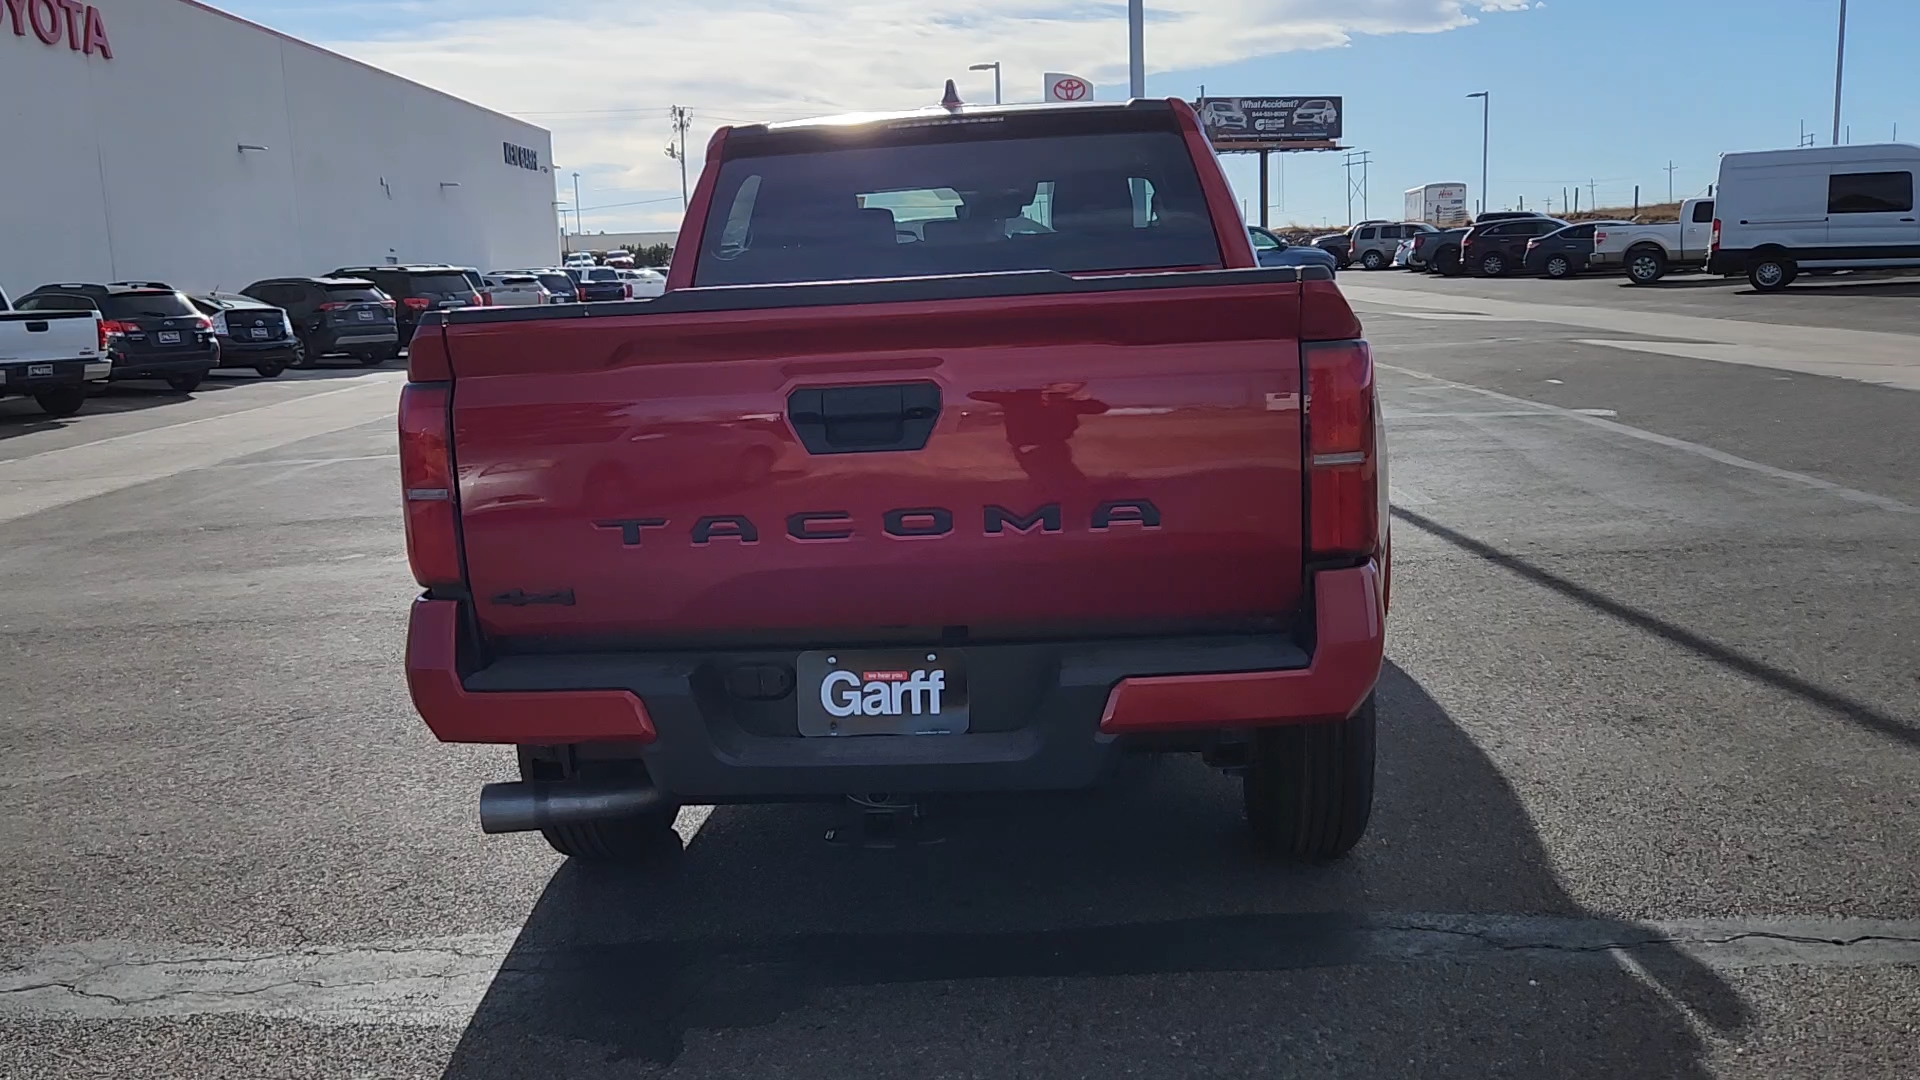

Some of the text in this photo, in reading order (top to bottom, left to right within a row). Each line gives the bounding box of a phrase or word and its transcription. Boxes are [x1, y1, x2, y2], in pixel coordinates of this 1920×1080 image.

[0, 0, 113, 59] YOTA
[1241, 99, 1299, 109] What Accident?
[590, 498, 1162, 548] TACOMA
[820, 669, 946, 718] Garff
[877, 671, 890, 679] hear
[891, 673, 904, 681] you
